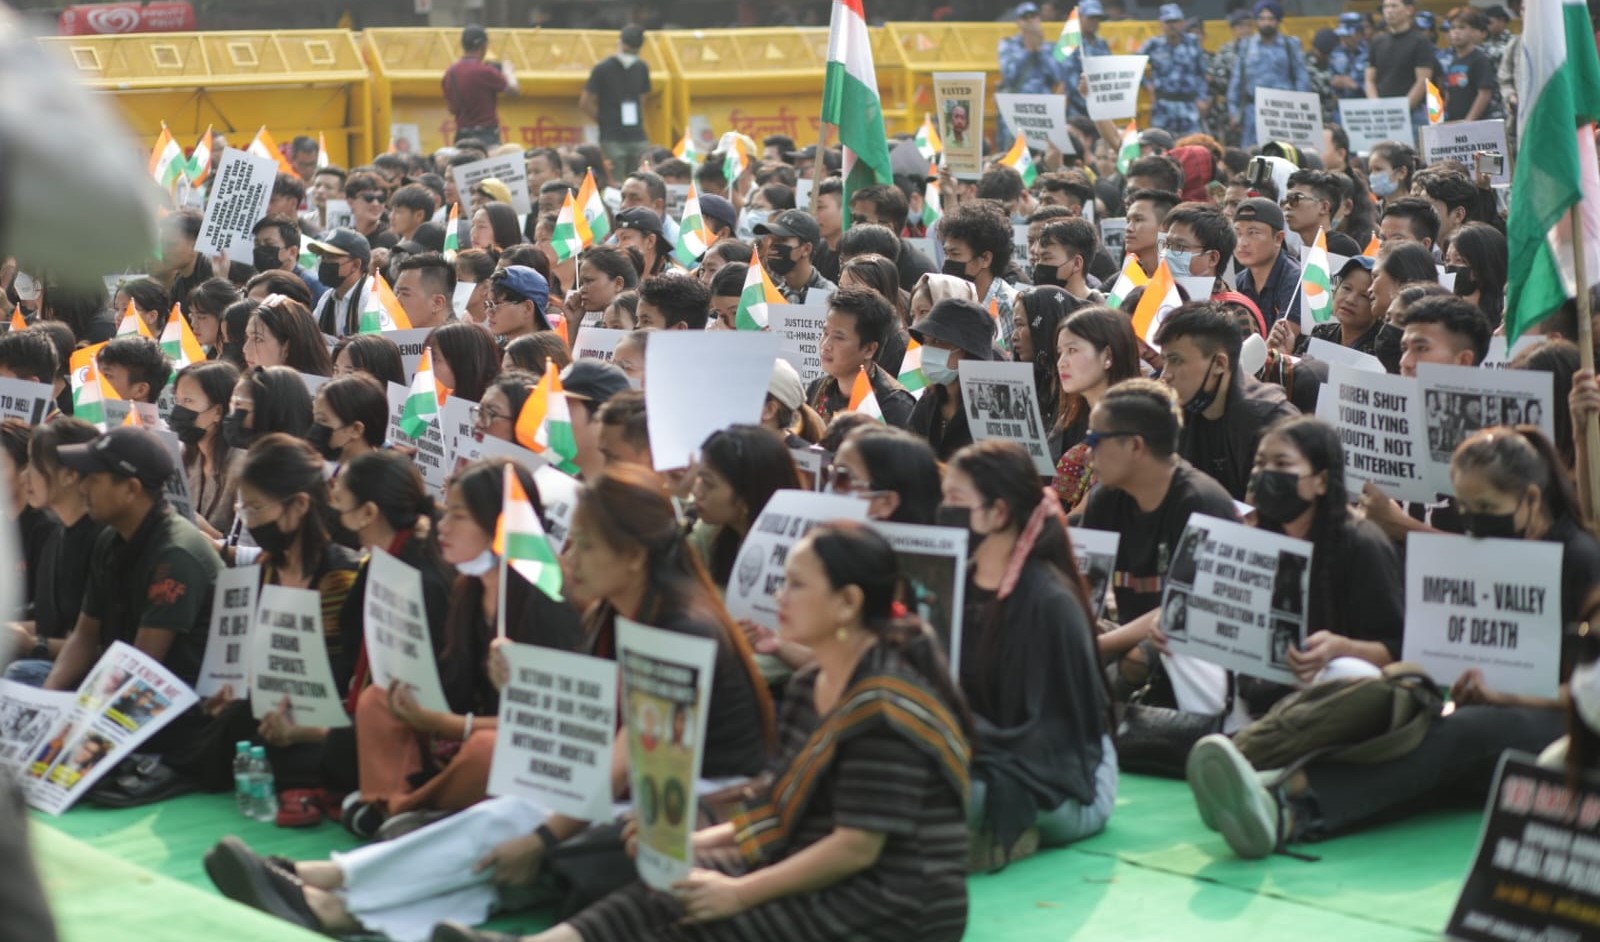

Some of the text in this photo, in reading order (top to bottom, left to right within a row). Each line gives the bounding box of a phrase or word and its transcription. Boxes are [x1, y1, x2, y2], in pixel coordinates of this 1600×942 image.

[941, 87, 972, 95] WANTED
[1013, 116, 1054, 128] PRECEDES
[1014, 103, 1047, 114] JUSTICE
[1431, 142, 1498, 155] COMPENSATION
[1455, 135, 1468, 143] NO
[226, 180, 235, 195] WE
[231, 159, 241, 177] DID
[206, 164, 232, 237] TO OUR FUTURE
[224, 164, 254, 248] WE FOUGHT HARD
[236, 185, 255, 231] FOR YOUR
[216, 234, 225, 252] NOT
[222, 195, 238, 230] REMAIN
[784, 318, 812, 328] JUSTICE
[799, 344, 817, 354] MIZO
[1, 395, 30, 412] TO HELL
[1339, 383, 1408, 413] BIREN SHUT
[986, 421, 1023, 438] JUSTICE FOR OUR
[1339, 404, 1409, 435] YOUR LYING
[418, 451, 440, 468] MORTAL
[1384, 438, 1413, 457] NOT
[1218, 542, 1234, 558] CAN
[1235, 546, 1247, 562] NO
[1247, 550, 1279, 571] LONGER
[1197, 557, 1272, 590] LIVE WITH RAPISTS
[1213, 580, 1253, 604] SEPARATE
[1423, 576, 1477, 607] IMPHAL
[1494, 582, 1546, 615] VALLEY
[1187, 594, 1254, 624] ADMINISTRATION
[1256, 612, 1266, 628] IS
[1216, 621, 1240, 640] MUST
[1448, 615, 1518, 649] OF DEATH
[268, 654, 307, 675] SEPARATE
[257, 674, 328, 699] ADMINISTRATION
[519, 667, 602, 699] RETURN THE DEAD
[507, 686, 611, 724] BODIES OF OUR PEOPLE
[516, 710, 553, 733] MONTHS
[559, 720, 608, 746] MOURNING
[512, 731, 596, 766] WITHOUT MORTAL
[529, 758, 573, 783] REMAINS
